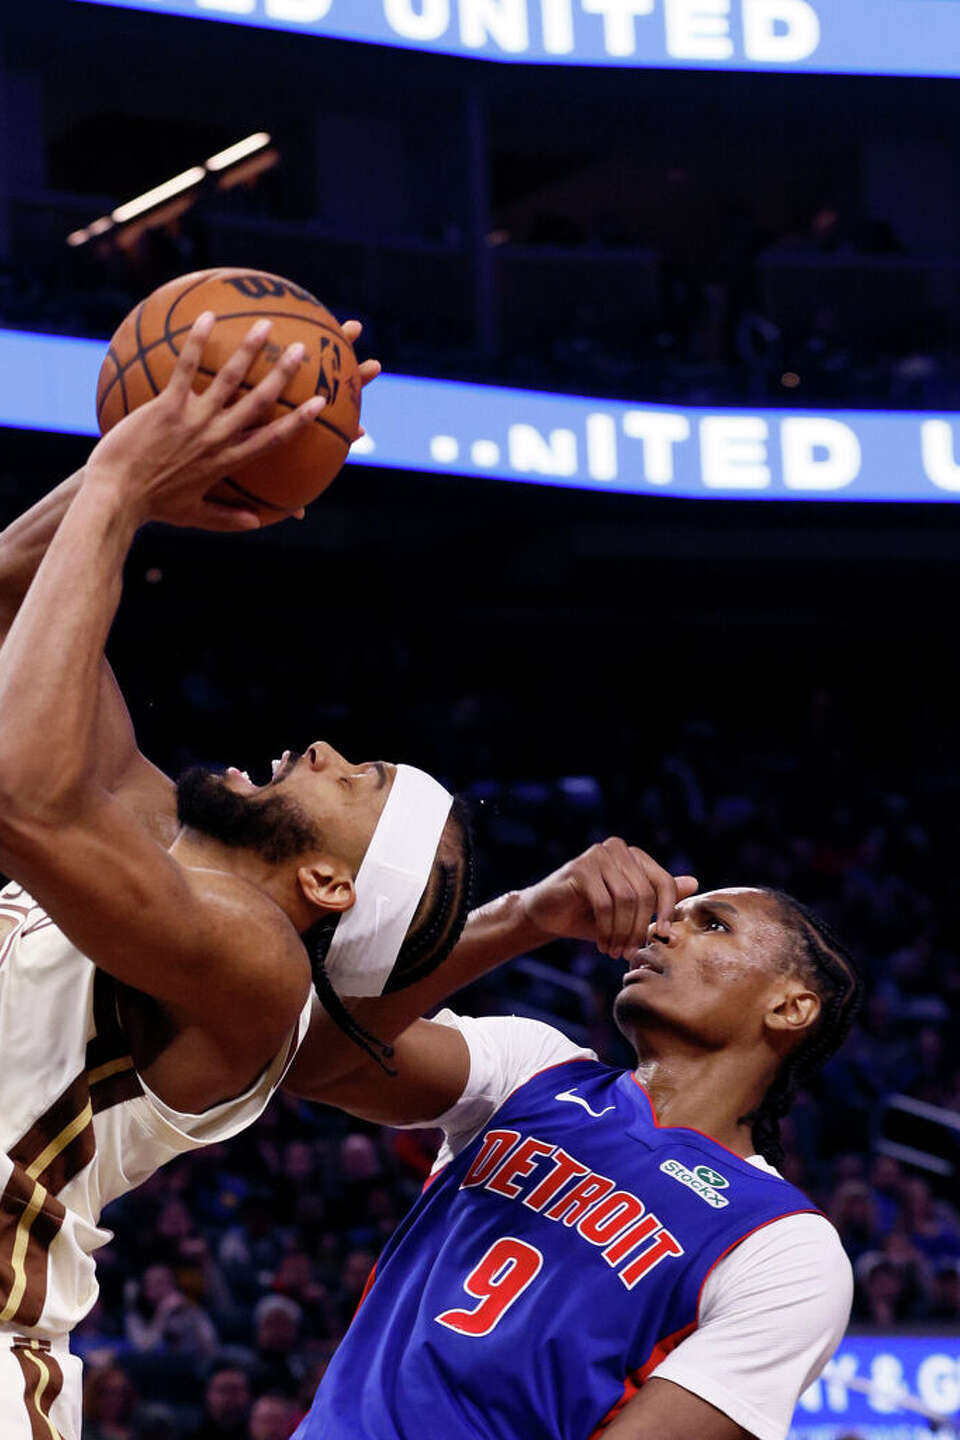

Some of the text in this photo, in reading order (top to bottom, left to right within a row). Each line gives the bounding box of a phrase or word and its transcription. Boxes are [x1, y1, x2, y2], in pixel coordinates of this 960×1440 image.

[383, 0, 821, 63] UNITED
[459, 1129, 684, 1291] DETROIT
[664, 1161, 726, 1206] StockX
[434, 1236, 544, 1338] 9
